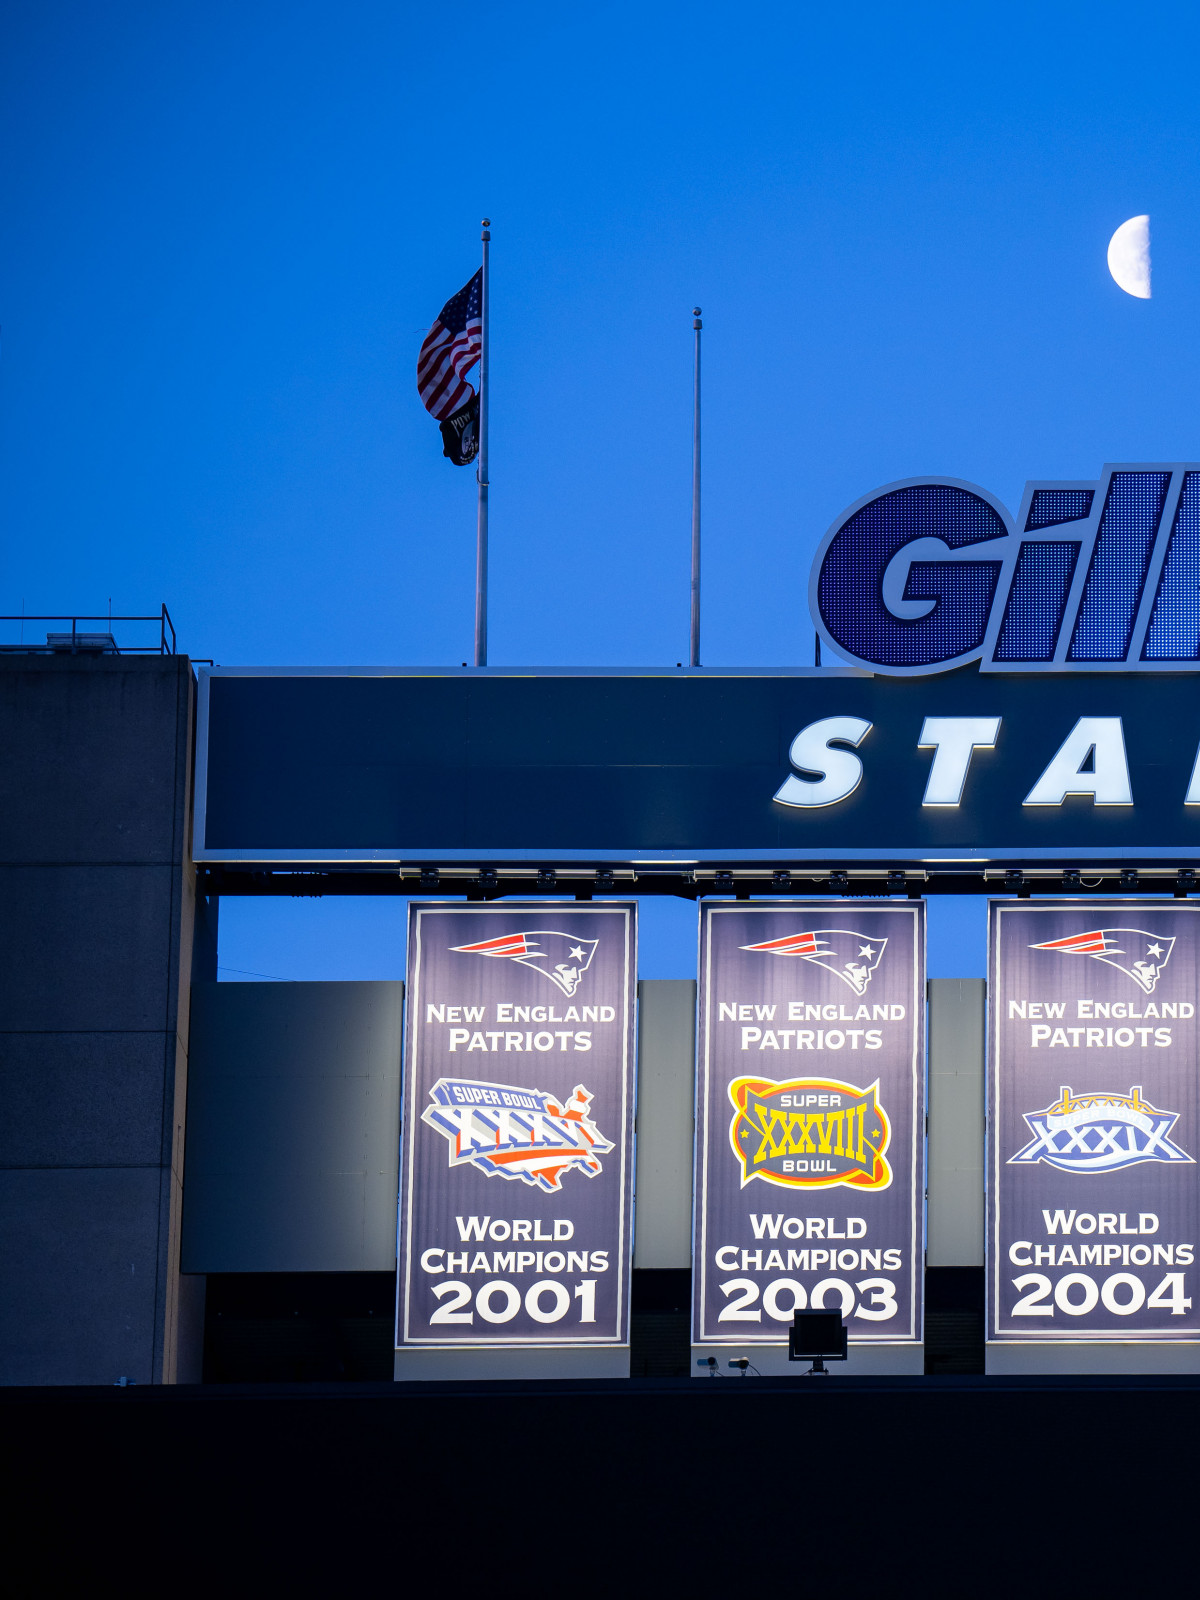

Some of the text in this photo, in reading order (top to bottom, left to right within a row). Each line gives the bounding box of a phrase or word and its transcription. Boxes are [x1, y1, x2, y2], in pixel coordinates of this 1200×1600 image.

[427, 1003, 615, 1023] NEW ENGLAND
[719, 1002, 905, 1021] NEW ENGLAND
[1008, 999, 1194, 1020] NEW ENGLAND
[449, 1028, 592, 1051] PATRIOTS
[741, 1027, 882, 1049] PATRIOTS
[1031, 1024, 1172, 1047] PATRIOTS
[452, 1086, 541, 1110] SUPER BOWL
[780, 1095, 841, 1107] SUPER
[1053, 1108, 1148, 1128] SUPER BOWL
[430, 1108, 609, 1158] XXXVI
[754, 1103, 867, 1164] XXXVIII
[1019, 1121, 1184, 1159] XXXIX
[783, 1160, 837, 1172] BOWL
[456, 1216, 574, 1241] WORLD
[750, 1214, 866, 1238] WORLD
[1042, 1210, 1159, 1234] WORLD
[421, 1248, 608, 1273] CHAMPIONS
[716, 1246, 901, 1270] CHAMPIONS
[1009, 1241, 1194, 1265] CHAMPIONS
[430, 1280, 597, 1325] 2001
[718, 1278, 897, 1322] 2003
[1012, 1273, 1191, 1316] 2004
